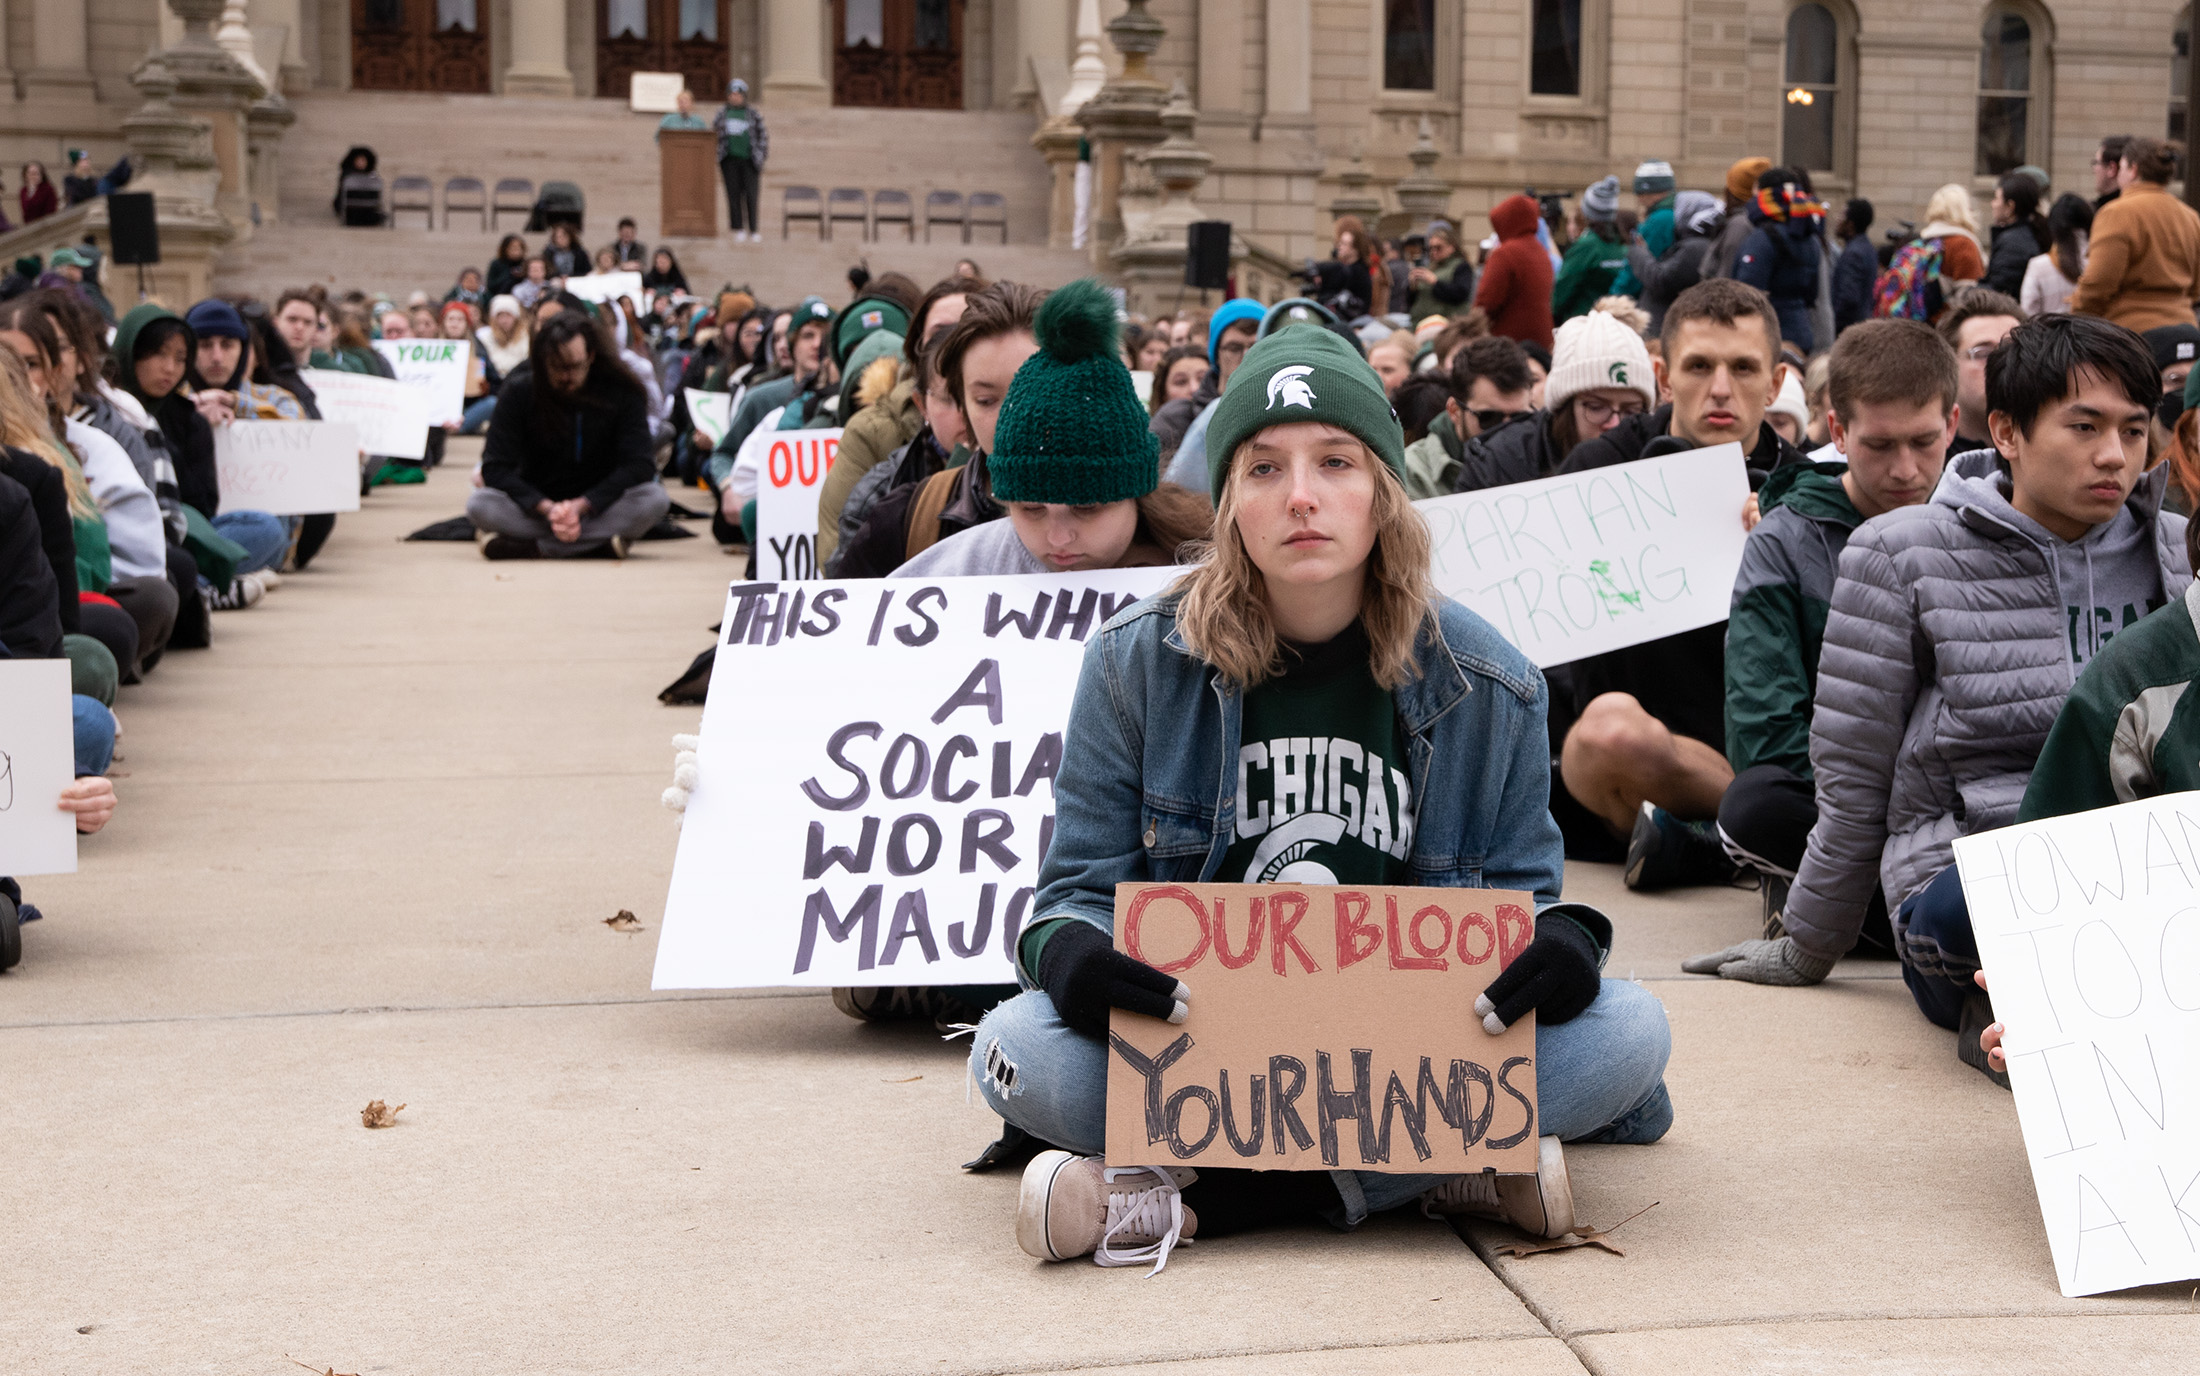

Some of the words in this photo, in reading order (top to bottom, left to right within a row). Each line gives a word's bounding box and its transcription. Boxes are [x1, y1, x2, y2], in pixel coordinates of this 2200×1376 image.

[397, 344, 457, 363] YOUR
[227, 425, 316, 453] MANY
[769, 534, 818, 581] YO
[1450, 544, 1692, 651] TRONG
[727, 583, 848, 646] THIS
[867, 587, 948, 646] IS
[930, 658, 1003, 725] A
[1956, 822, 2125, 931] HOW
[1124, 885, 1321, 977] OUR
[1335, 891, 1533, 974] BLOOD
[1109, 1030, 1314, 1159] YOUR
[1316, 1049, 1534, 1166] HANDS
[2013, 1033, 2164, 1159] IN
[2073, 1174, 2148, 1283] A
